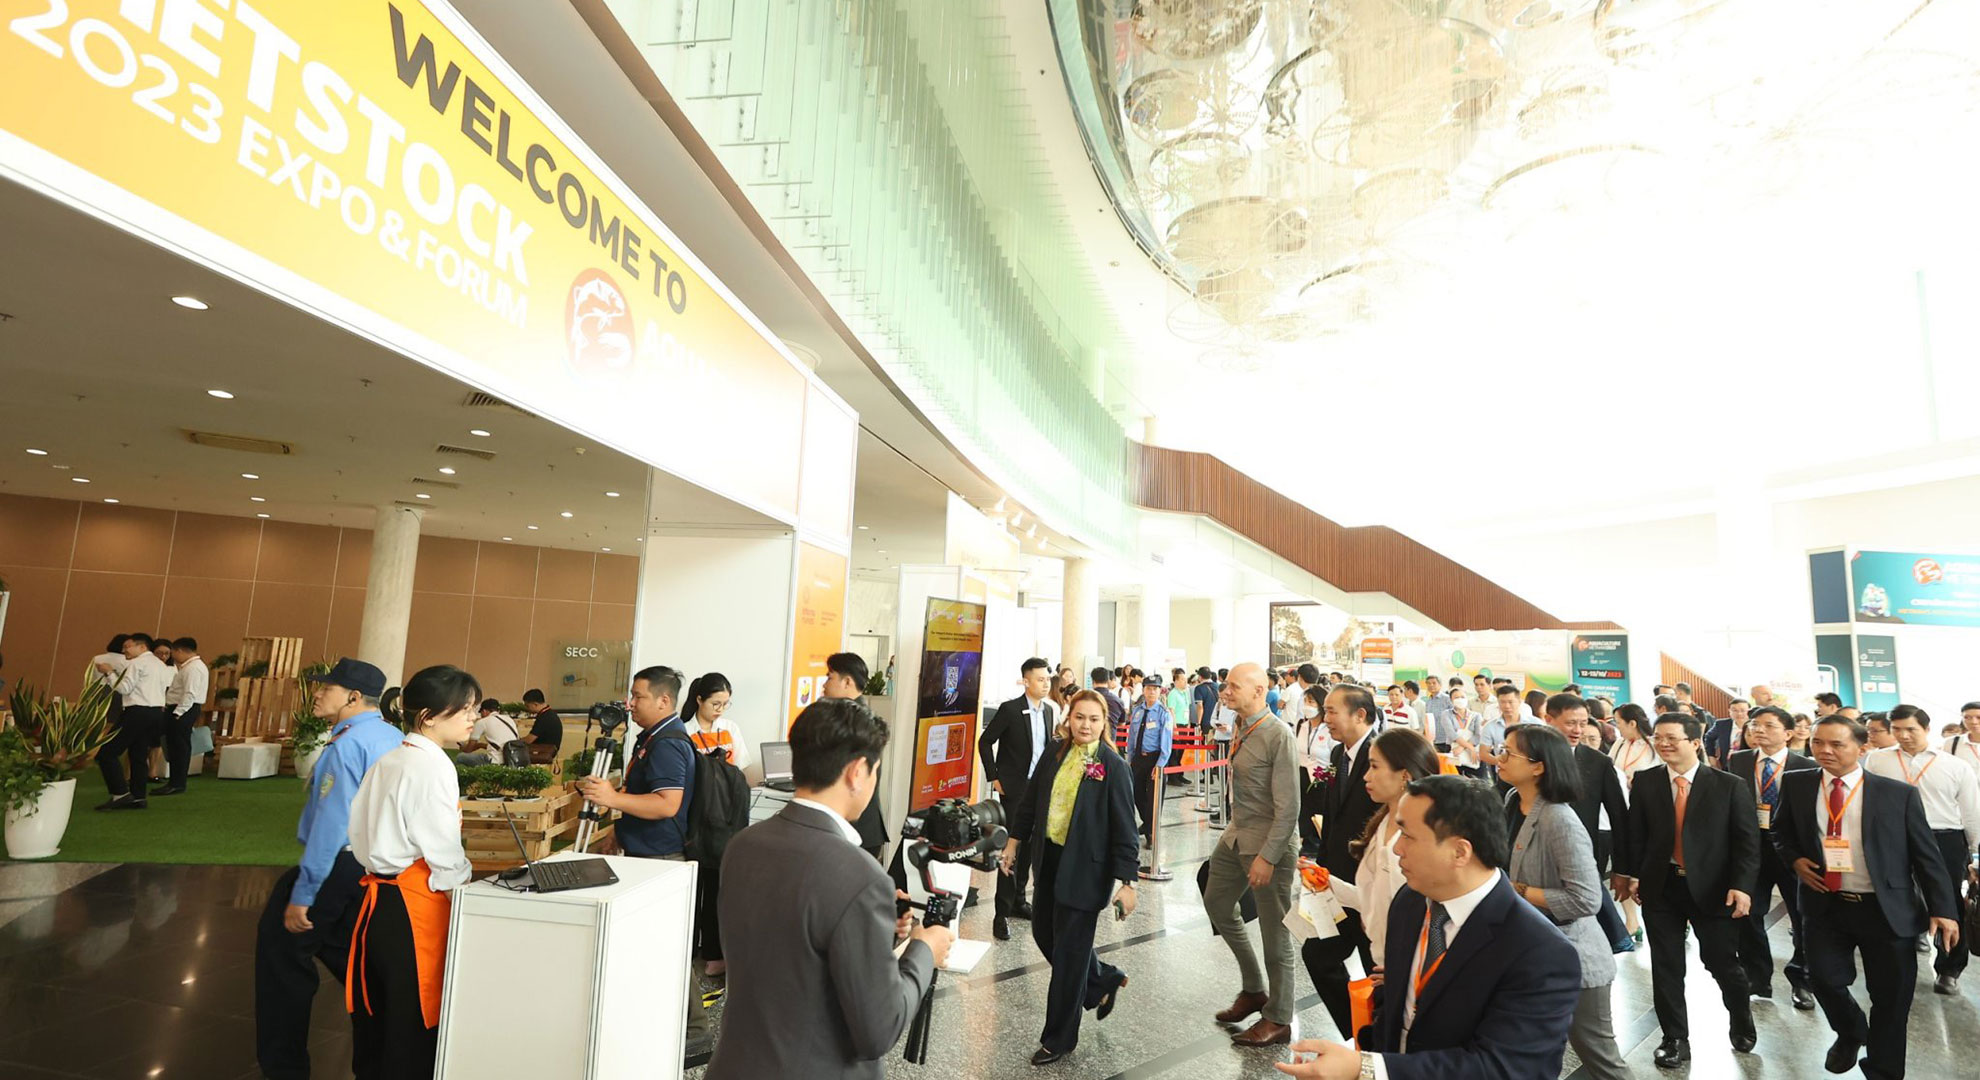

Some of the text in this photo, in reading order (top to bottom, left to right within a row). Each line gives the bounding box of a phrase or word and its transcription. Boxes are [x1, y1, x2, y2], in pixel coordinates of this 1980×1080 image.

[9, 0, 529, 329] 2023 EXPO & FORUM
[388, 2, 687, 315] WELCOME TO
[565, 646, 599, 658] SECC
[948, 846, 978, 861] RONIN
